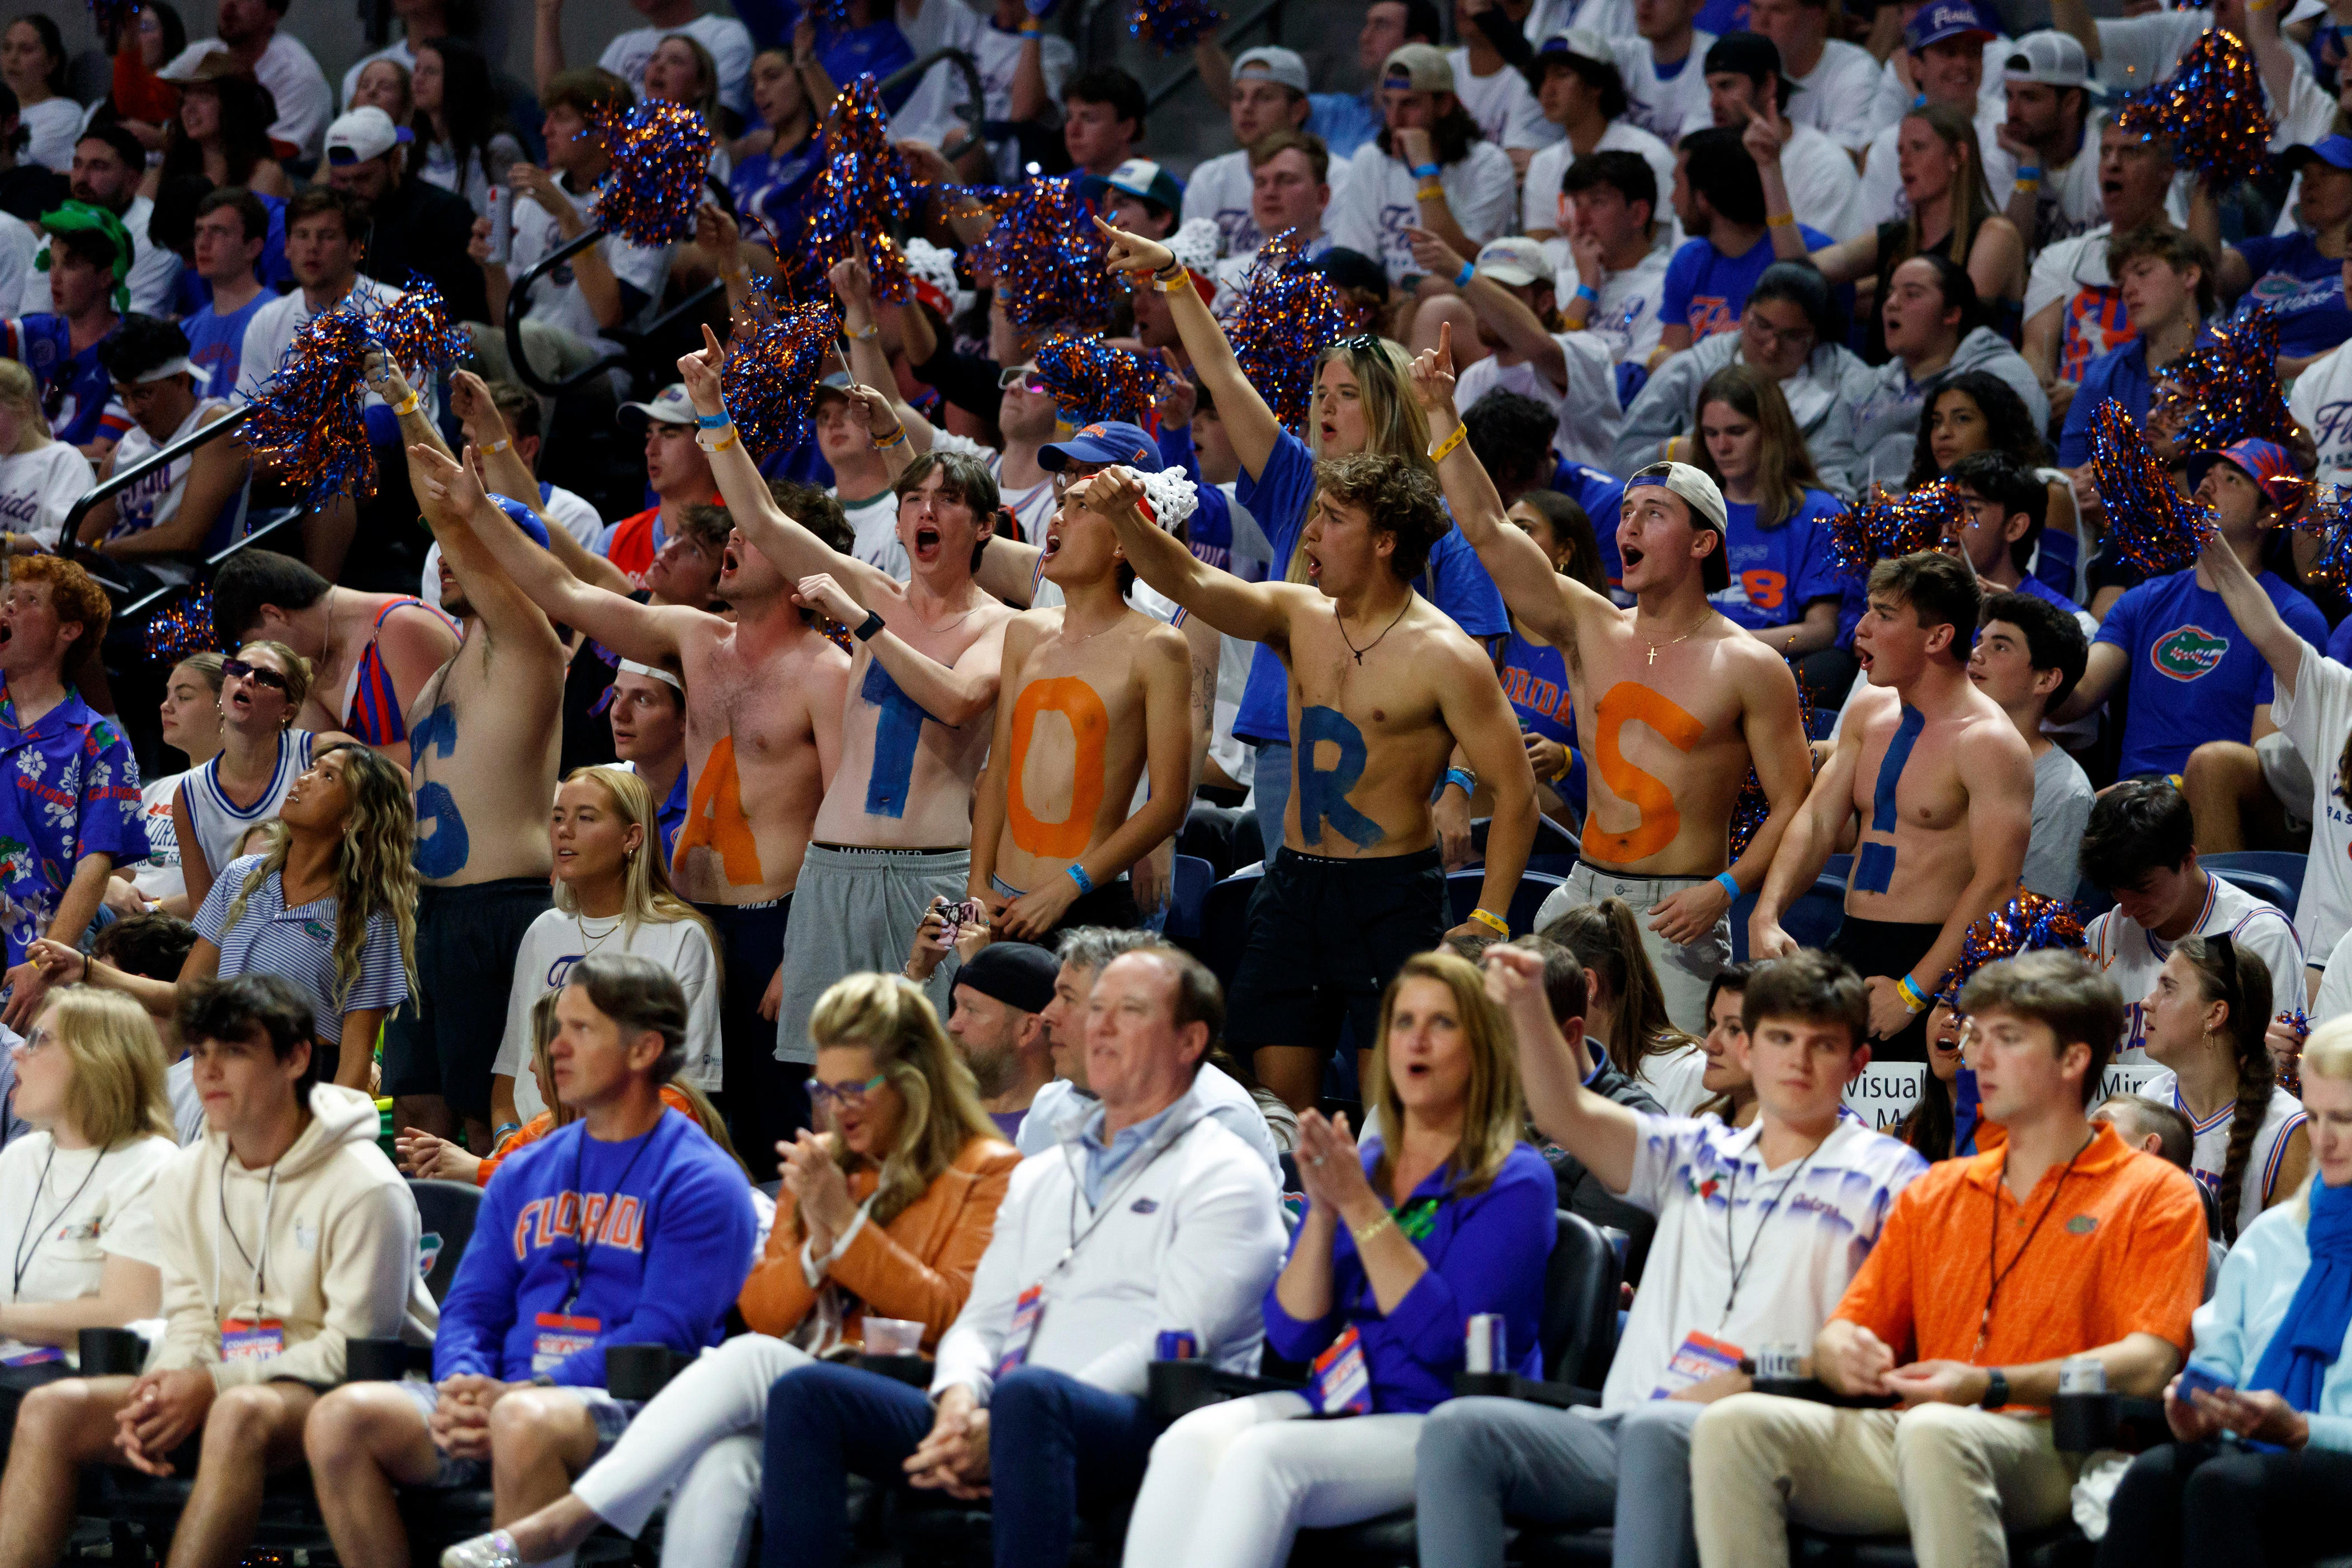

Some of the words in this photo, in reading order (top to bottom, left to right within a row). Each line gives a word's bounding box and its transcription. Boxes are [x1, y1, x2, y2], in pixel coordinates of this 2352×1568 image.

[1132, 448, 1148, 464] F
[1297, 705, 1386, 854] R
[1582, 681, 1705, 863] S
[17, 776, 76, 808] GATORS
[1846, 1069, 1924, 1098] Visual
